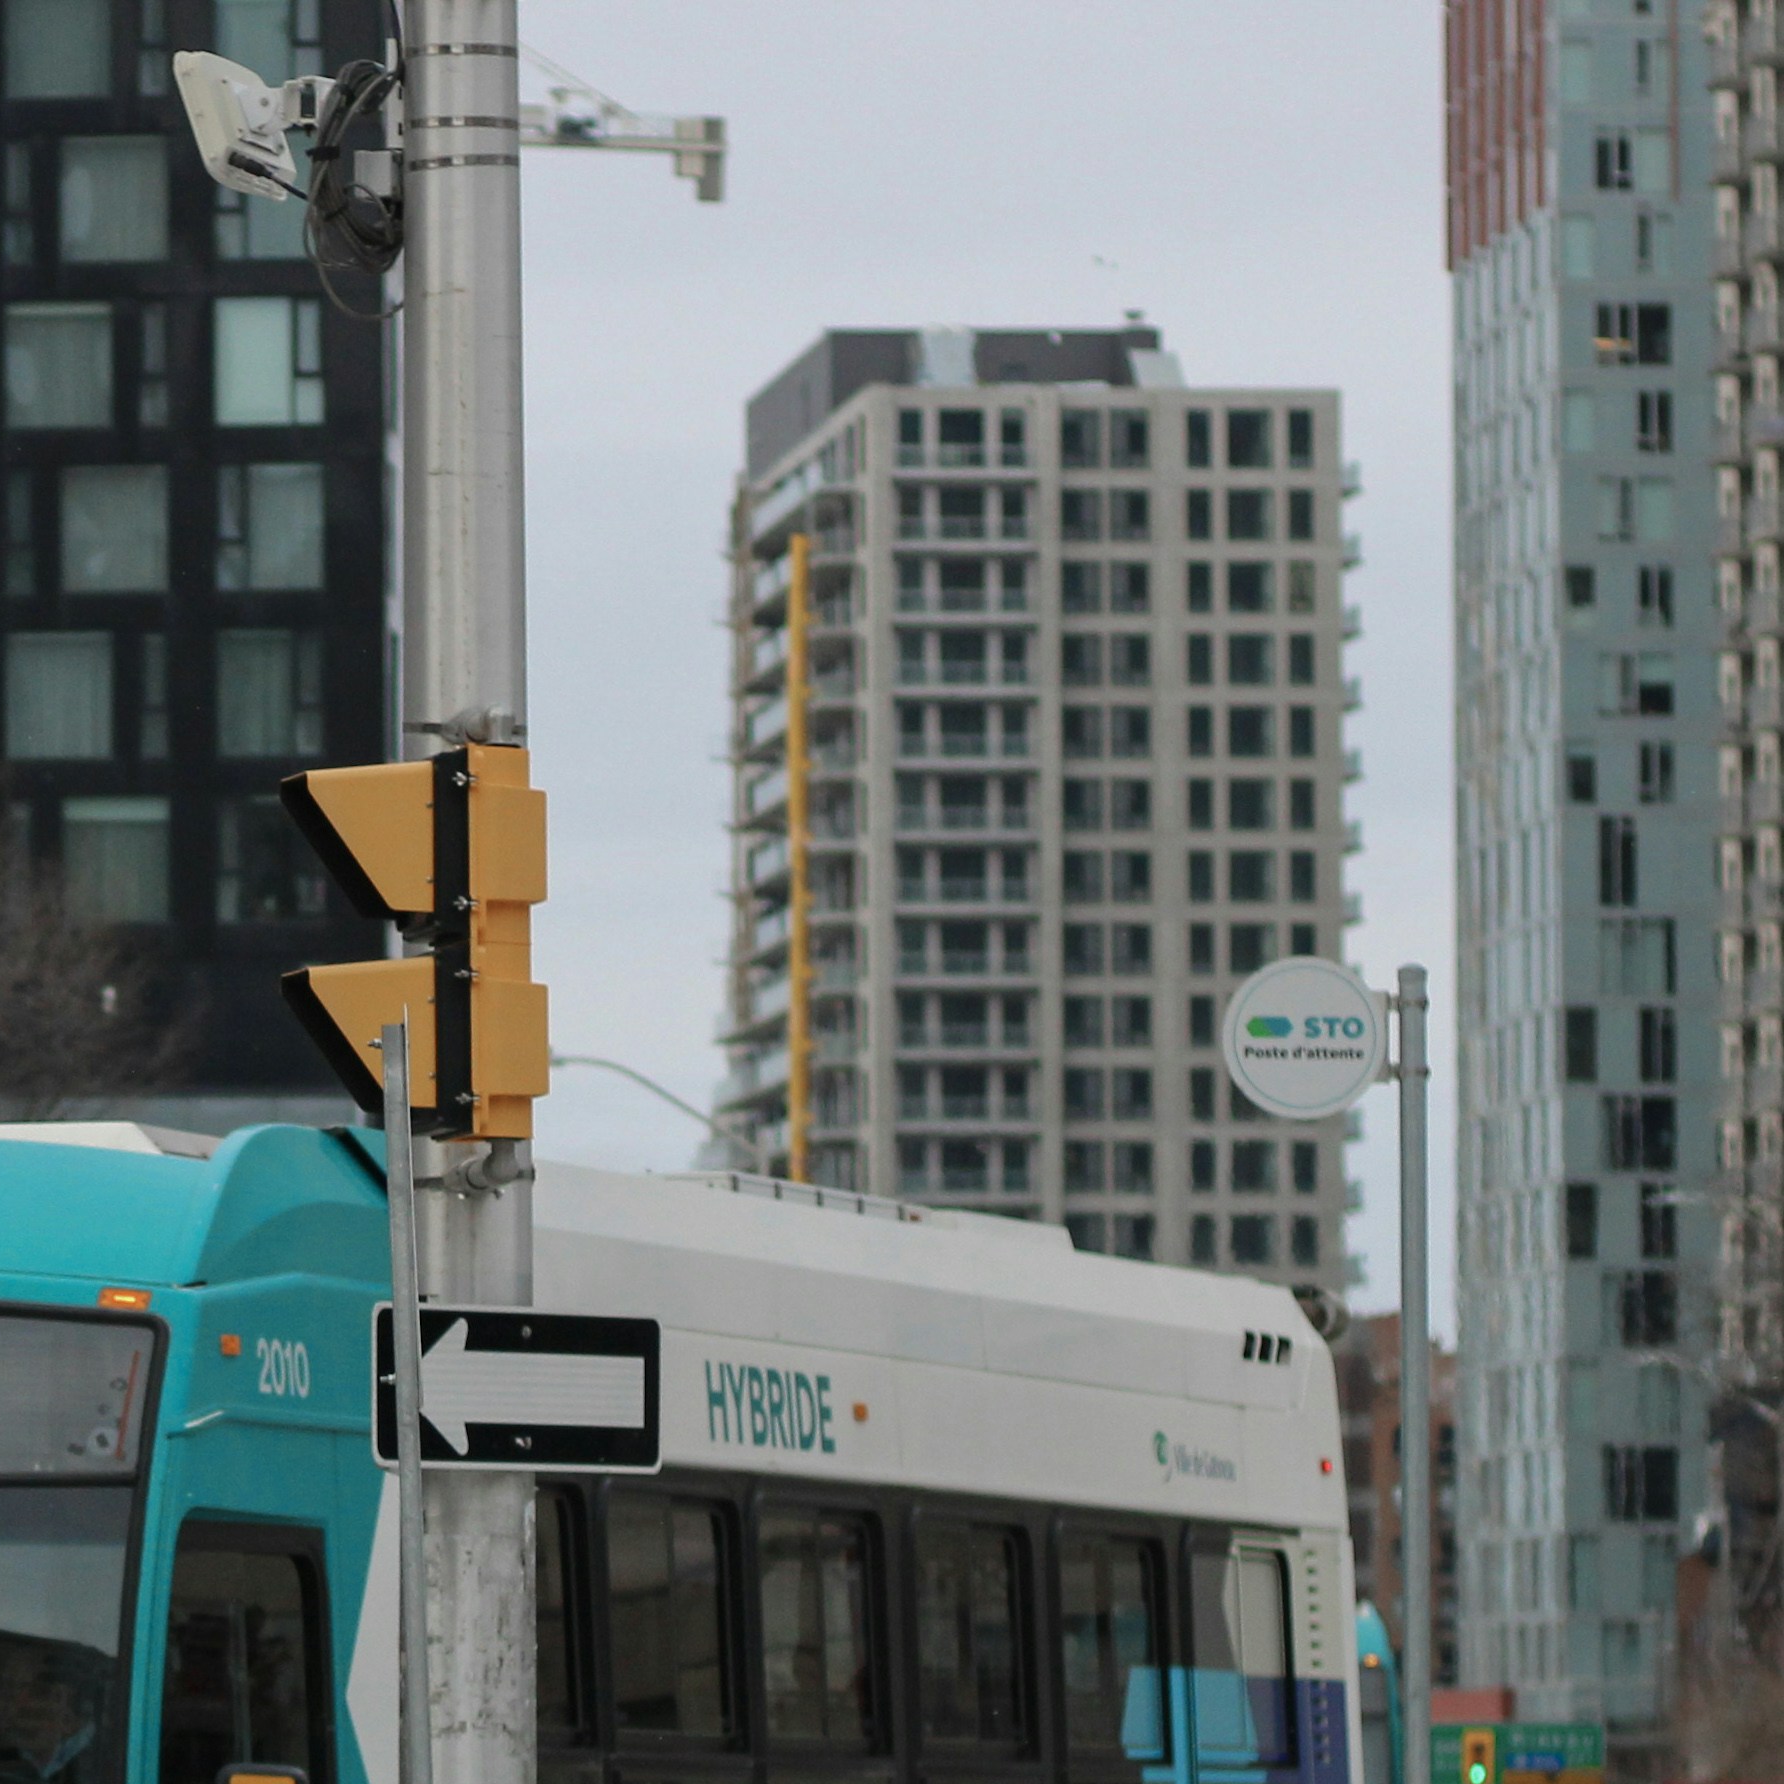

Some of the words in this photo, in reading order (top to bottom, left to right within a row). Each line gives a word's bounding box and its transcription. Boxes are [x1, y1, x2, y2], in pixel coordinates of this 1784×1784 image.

[1304, 1017, 1365, 1040] STO
[1244, 1046, 1288, 1060] Poste
[1293, 1046, 1365, 1060] d'attente
[257, 1337, 310, 1398] 2010
[704, 1360, 836, 1453] HYBRIDE
